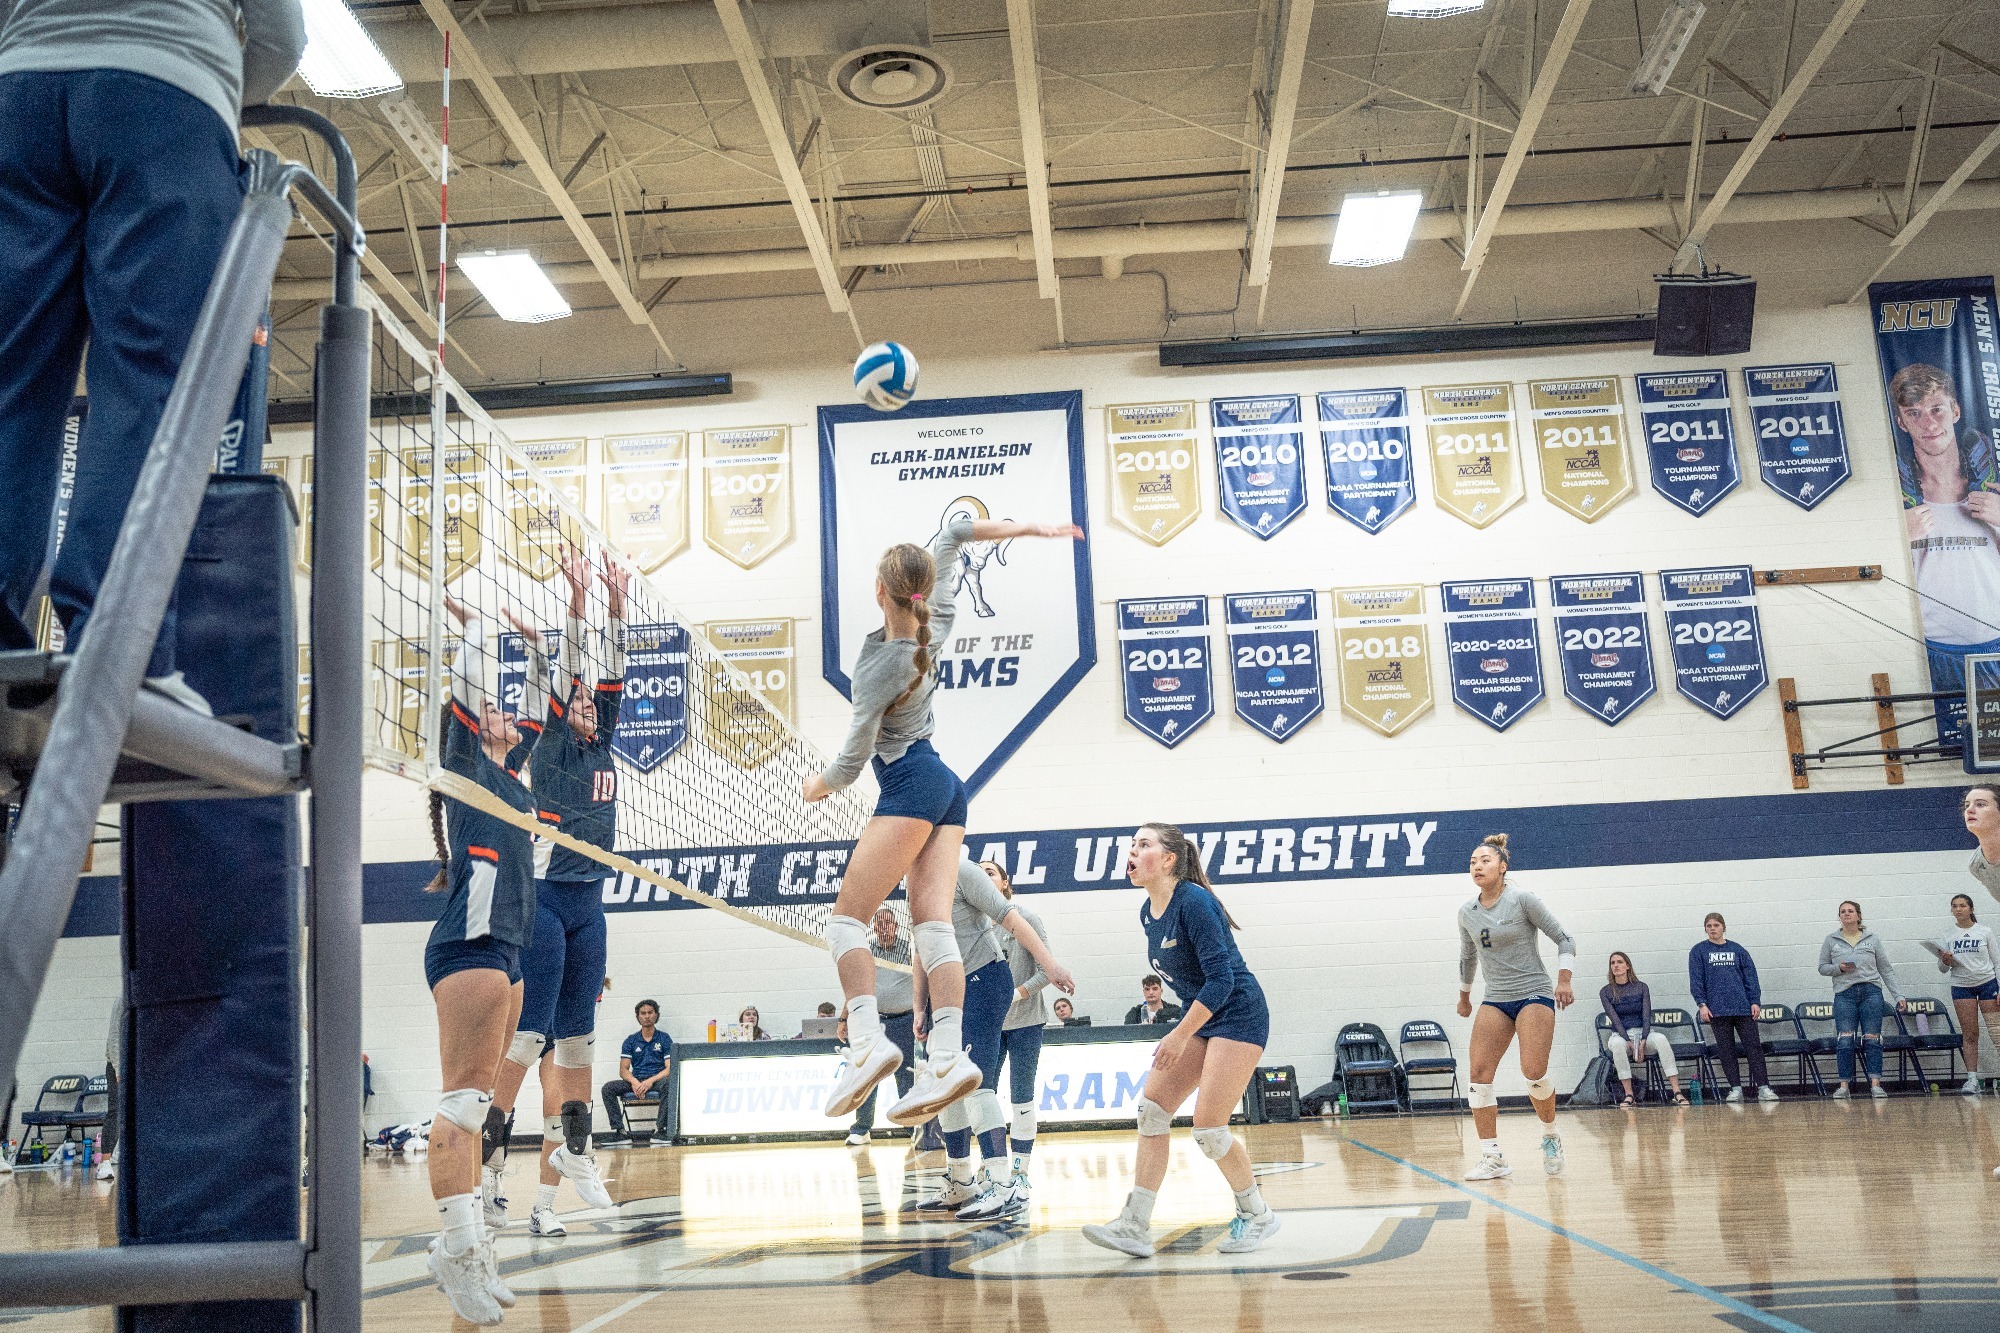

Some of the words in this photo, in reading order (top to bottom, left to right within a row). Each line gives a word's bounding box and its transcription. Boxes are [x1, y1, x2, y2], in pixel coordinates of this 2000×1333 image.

[1879, 298, 1960, 333] NCU
[1971, 295, 1994, 354] MEN'S
[1786, 370, 1824, 378] CENTRAL
[1677, 376, 1716, 384] CENTRAL
[1464, 389, 1501, 397] CENTRAL
[1982, 362, 2000, 420] CROSS
[1147, 406, 1184, 414] CENTRAL
[1651, 420, 1724, 443] 2011
[1760, 415, 1833, 438] 2011
[918, 429, 967, 438] WELCOME
[970, 428, 984, 436] TO
[1544, 426, 1616, 448] 2011
[1436, 433, 1508, 455] 2011
[871, 443, 1032, 464] CLARK-DANIELSON
[1223, 444, 1296, 467] 2010
[1329, 439, 1403, 462] 2010
[60, 416, 79, 501] WOMEN'S
[1117, 450, 1190, 472] 2010
[1567, 460, 1600, 468] NCCAA
[1786, 457, 1842, 465] TOURNAMENT
[899, 463, 1006, 481] GYMNASIUM
[1459, 466, 1491, 475] NCCAA
[1564, 471, 1604, 479] NATIONAL
[1776, 466, 1829, 474] PARTICIPANT
[1562, 479, 1609, 487] CHAMPIONS
[1670, 474, 1717, 482] CHAMPIONS
[711, 474, 782, 496] 2007
[1139, 483, 1172, 492] NCCAA
[1354, 481, 1409, 490] TOURNAMENT
[608, 481, 680, 503] 2007
[1235, 489, 1290, 497] TOURNAMENT
[1344, 491, 1396, 499] PARTICIPANT
[1453, 487, 1500, 496] CHAMPIONS
[1133, 503, 1180, 511] CHAMPIONS
[1240, 498, 1286, 506] CHAMPIONS
[731, 507, 762, 515] NCCAA
[629, 514, 660, 523] NCCAA
[1562, 581, 1590, 589] NORTH
[1593, 578, 1633, 587] CENTRAL
[1670, 575, 1700, 584] NORTH
[1702, 572, 1742, 581] CENTRAL
[1484, 584, 1523, 592] CENTRAL
[1158, 602, 1197, 610] CENTRAL
[1236, 599, 1265, 607] NORTH
[1266, 596, 1305, 604] CENTRAL
[1675, 620, 1752, 644] 2022
[955, 637, 981, 653] OF
[991, 634, 1033, 651] THE
[1564, 626, 1641, 650] 2022
[1345, 636, 1420, 659] 2018
[1452, 639, 1533, 652] 2020-2021
[1129, 648, 1202, 671] 2012
[1238, 644, 1311, 667] 2012
[934, 656, 1019, 690] AMS
[1702, 664, 1759, 673] TOURNAMENT
[1368, 672, 1402, 681] NCCAA
[1578, 671, 1635, 679] TOURNAMENT
[1692, 674, 1746, 682] PARTICIPANT
[622, 676, 683, 699] 009
[1584, 680, 1632, 688] CHAMPIONS
[1261, 687, 1317, 696] TOURNAMENT
[1140, 695, 1196, 704] TOURNAMENT
[1251, 697, 1304, 706] PARTICIPANT
[1144, 704, 1192, 712] CHAMPIONS
[592, 771, 615, 802] 10
[602, 853, 756, 903] ORTH
[779, 840, 1047, 894] CEAL
[1074, 821, 1437, 882] UNVERSITY
[1480, 928, 1491, 948] 2
[1954, 940, 1980, 949] NCU
[1709, 952, 1735, 963] NCU
[1806, 1005, 1833, 1016] NCU
[1906, 1002, 1934, 1012] NCU
[1654, 1012, 1681, 1023] NCU
[1758, 1008, 1783, 1020] NCU
[718, 1070, 761, 1083] NORTH
[768, 1069, 827, 1080] CENTRAL
[51, 1078, 79, 1089] NCU
[1040, 1071, 1149, 1110] RAM
[703, 1084, 898, 1114] DOWNT
